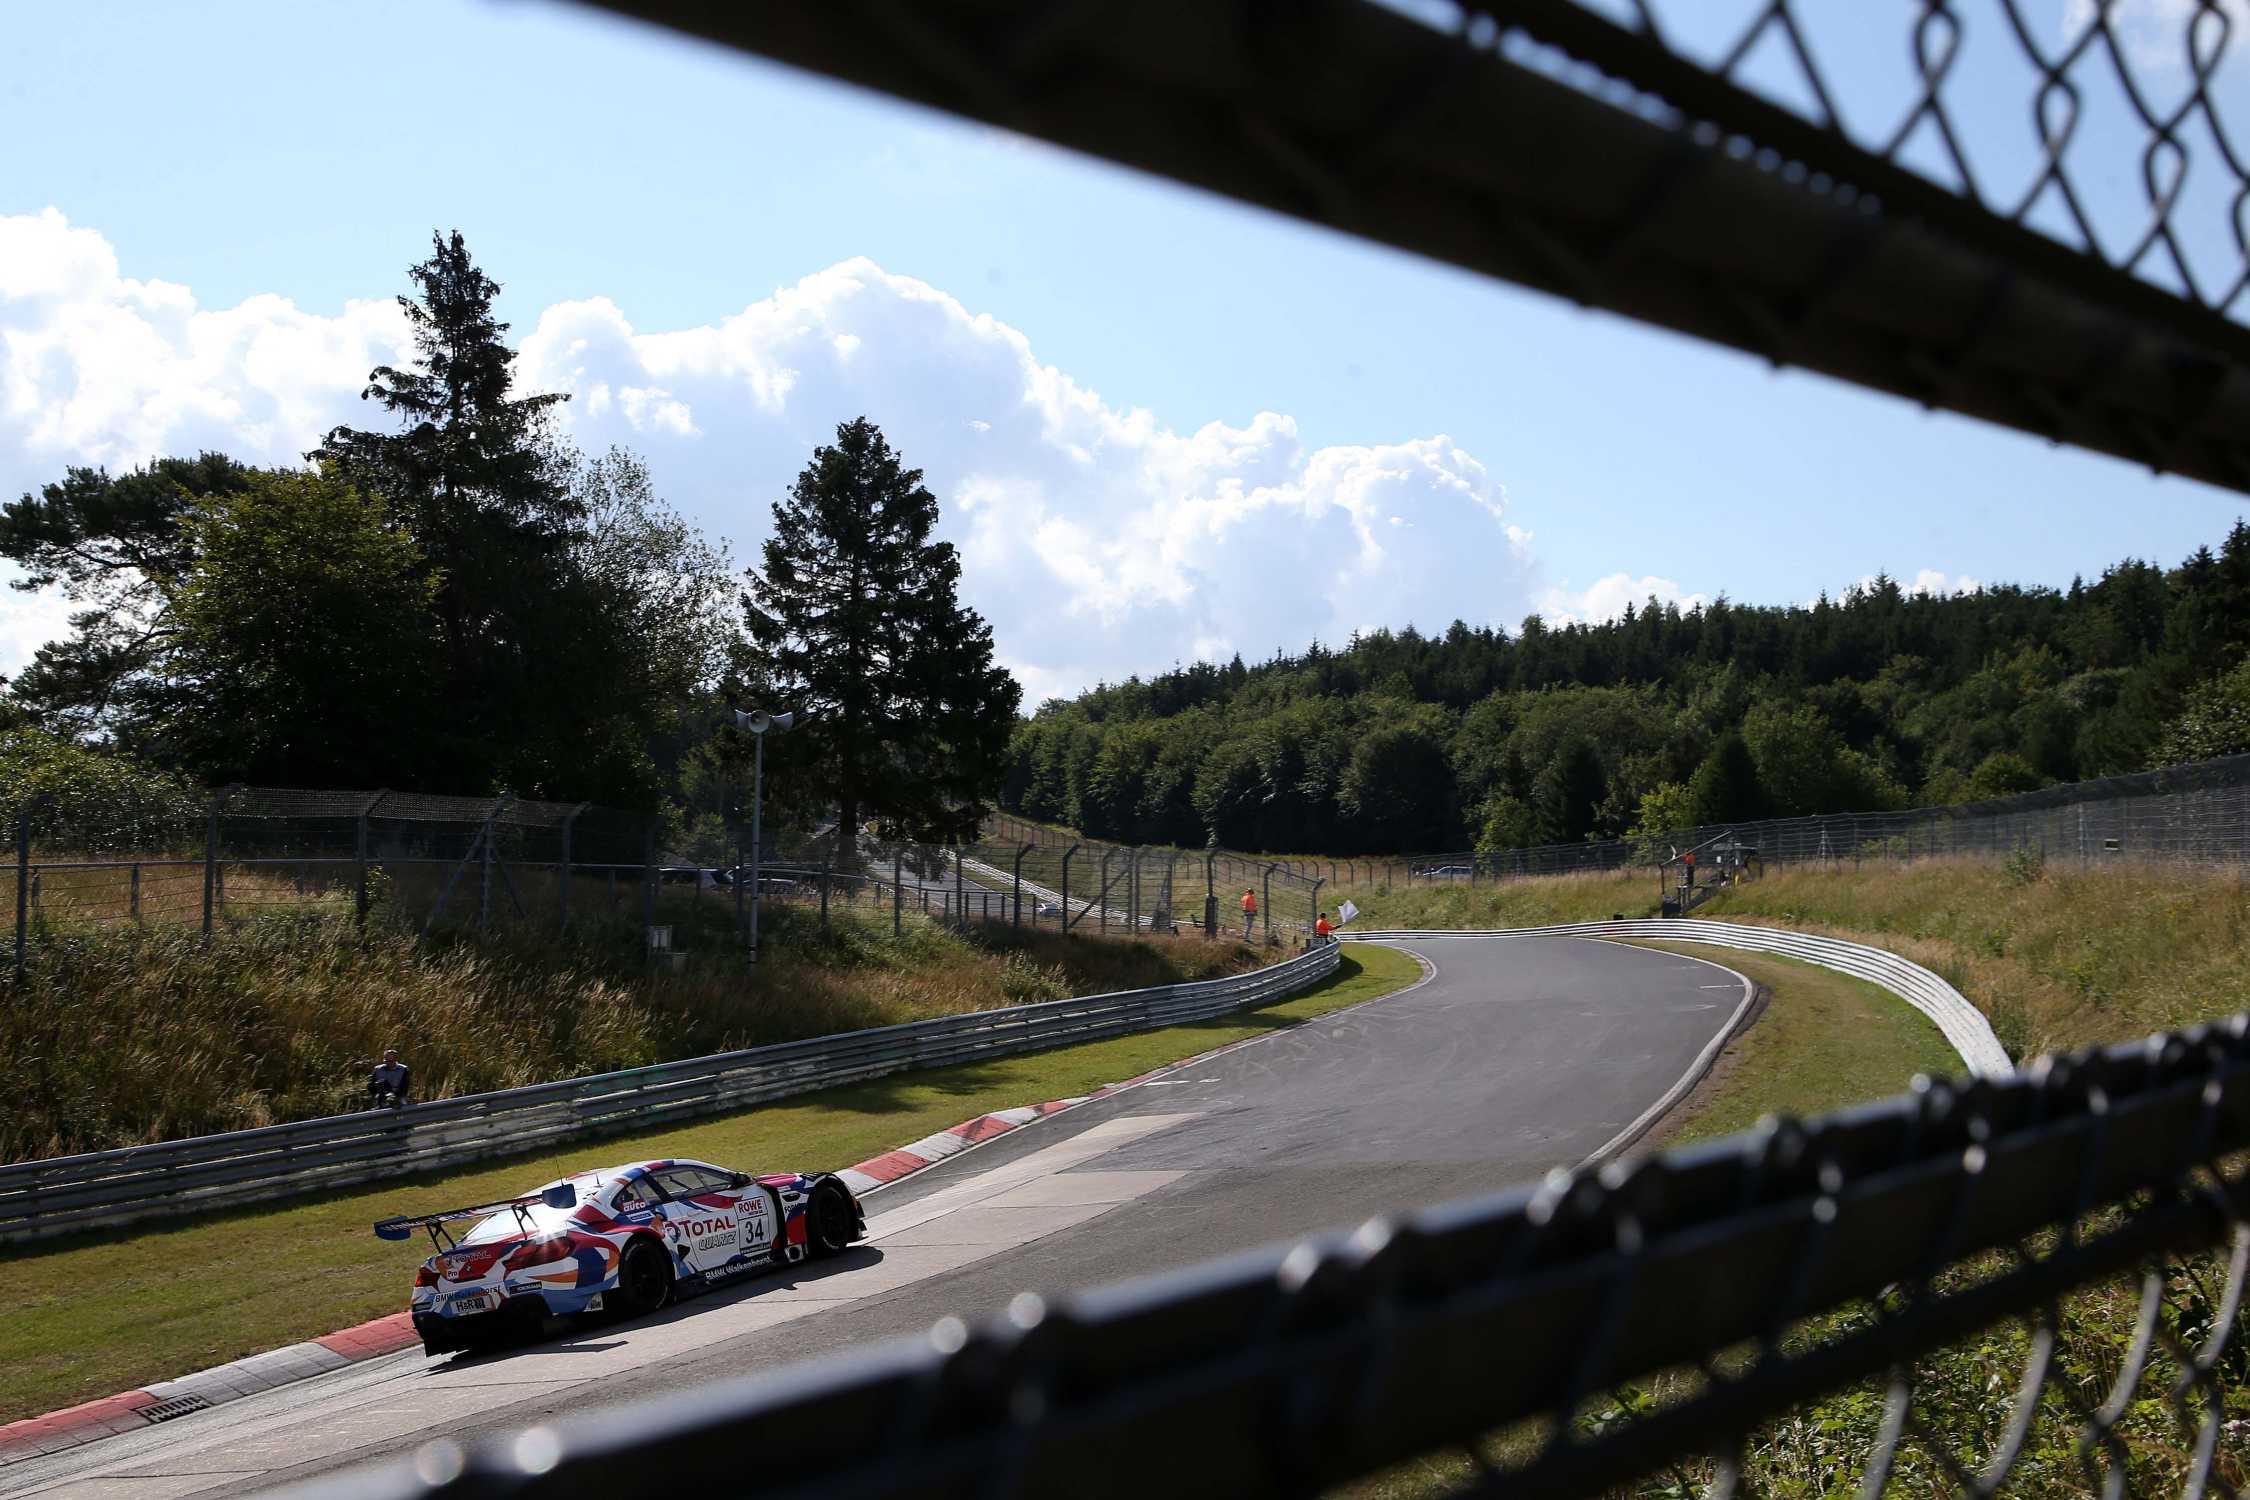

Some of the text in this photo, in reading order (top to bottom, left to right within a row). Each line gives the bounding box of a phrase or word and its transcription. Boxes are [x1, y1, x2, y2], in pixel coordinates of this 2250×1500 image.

[623, 1201, 646, 1212] auto
[738, 1199, 763, 1213] ROWE
[678, 1216, 736, 1238] TOTAL
[745, 1218, 764, 1243] 34
[699, 1231, 736, 1251] QUARTZ
[705, 1268, 726, 1280] BMW
